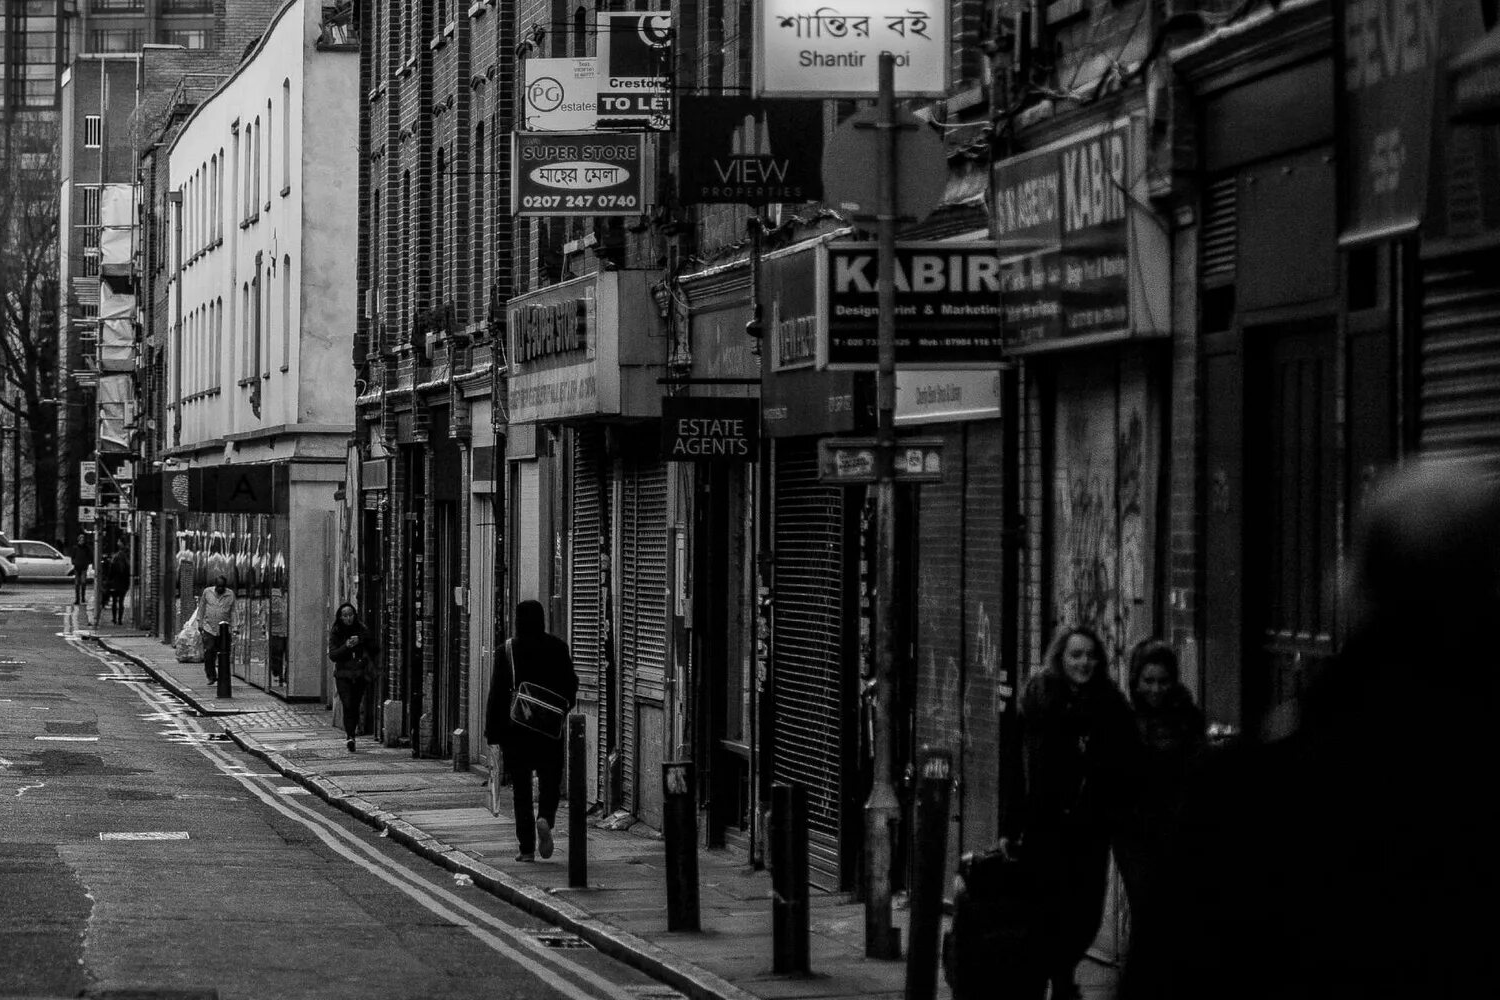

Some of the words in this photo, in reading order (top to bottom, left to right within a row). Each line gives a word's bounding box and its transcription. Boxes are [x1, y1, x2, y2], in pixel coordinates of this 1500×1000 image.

[776, 7, 871, 38] শান্তির
[884, 9, 932, 40] বই
[799, 50, 866, 67] Shantir
[533, 86, 560, 103] PG
[561, 102, 597, 112] estates
[601, 97, 631, 111] TO
[522, 145, 578, 160] SUPER
[582, 145, 637, 160] STORE
[713, 159, 790, 184] VIEW
[700, 186, 803, 198] PROPERTIES
[1063, 134, 1127, 233] KABIR
[523, 195, 562, 208] 0207
[565, 195, 594, 208] 247
[597, 195, 637, 208] 0740
[835, 304, 879, 318] Design
[892, 304, 918, 316] rint
[923, 304, 935, 316] &
[940, 304, 1001, 316] Marketin
[678, 418, 744, 437] ESTATE
[672, 438, 749, 455] AGENTS
